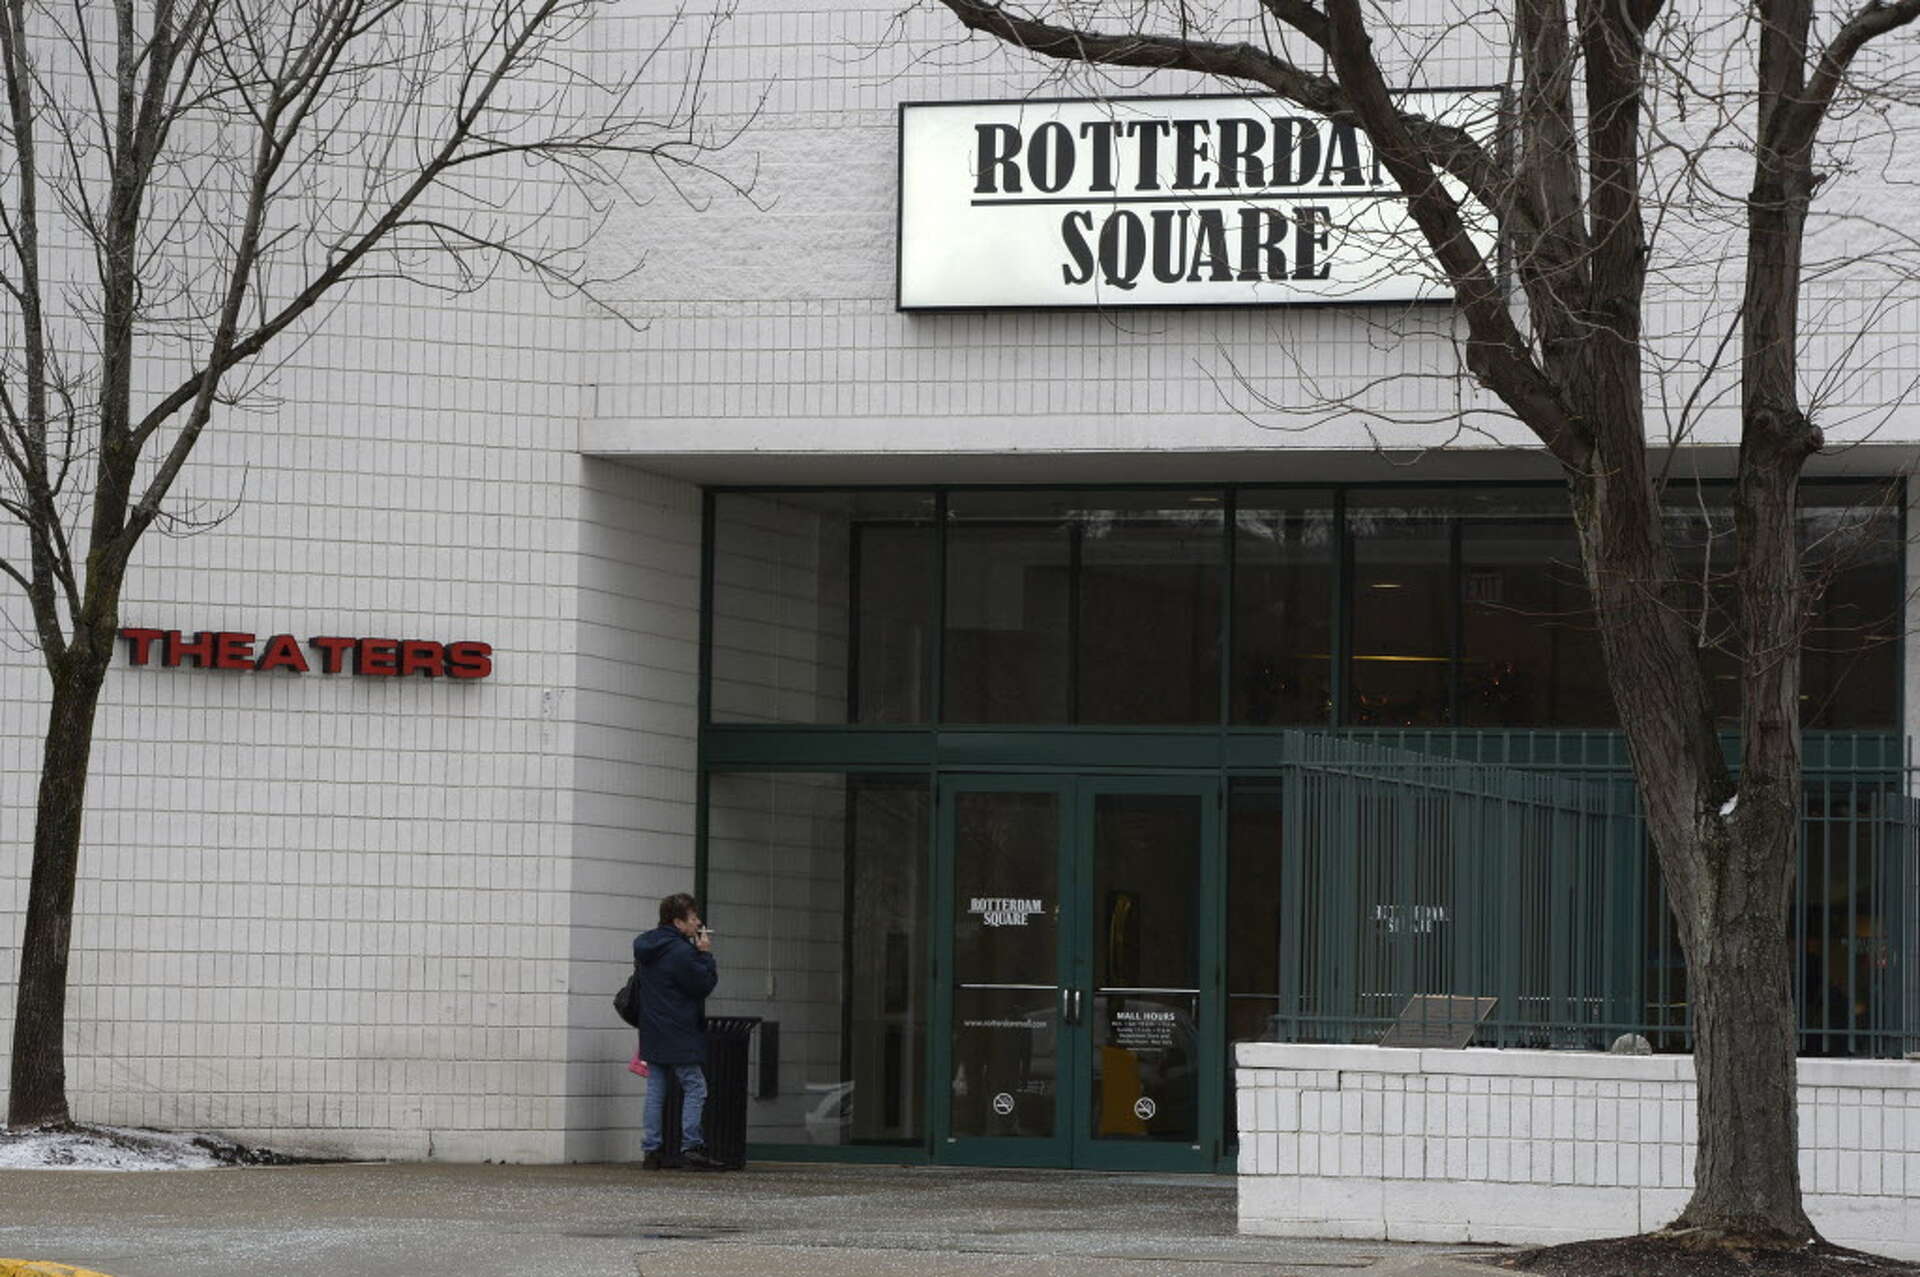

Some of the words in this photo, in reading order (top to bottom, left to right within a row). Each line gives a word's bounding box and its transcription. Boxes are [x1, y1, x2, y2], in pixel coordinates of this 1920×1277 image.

[973, 117, 1385, 194] ROTTERDA
[1061, 205, 1332, 290] SQUARE
[118, 627, 493, 679] THEATERS
[970, 898, 1042, 912] ROTTERDAM
[983, 911, 1029, 927] SQUARE
[1116, 1011, 1141, 1021] MALL
